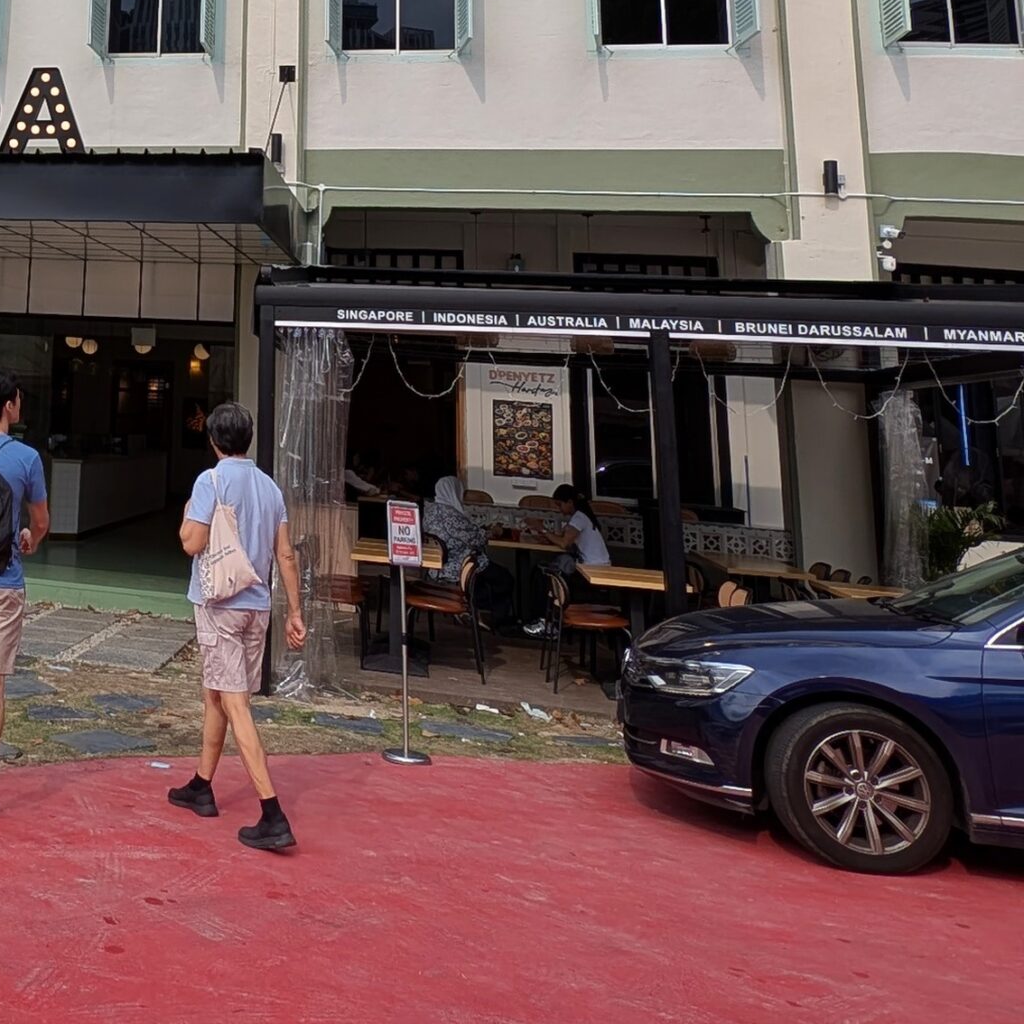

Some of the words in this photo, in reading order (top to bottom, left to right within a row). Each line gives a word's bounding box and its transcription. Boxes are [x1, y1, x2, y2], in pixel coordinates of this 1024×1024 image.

[337, 309, 414, 322] SINGAPORE
[433, 312, 508, 325] INDONESIA
[527, 315, 608, 328] AUSTRALIA
[629, 318, 704, 332] MALAYSIA
[735, 321, 793, 335] BRUNEI
[797, 324, 907, 339] DARUSSALAM
[943, 328, 1024, 343] MYANMAR
[489, 368, 555, 384] D'PENYETZ
[398, 525, 411, 536] NO
[394, 536, 416, 544] PARKING
